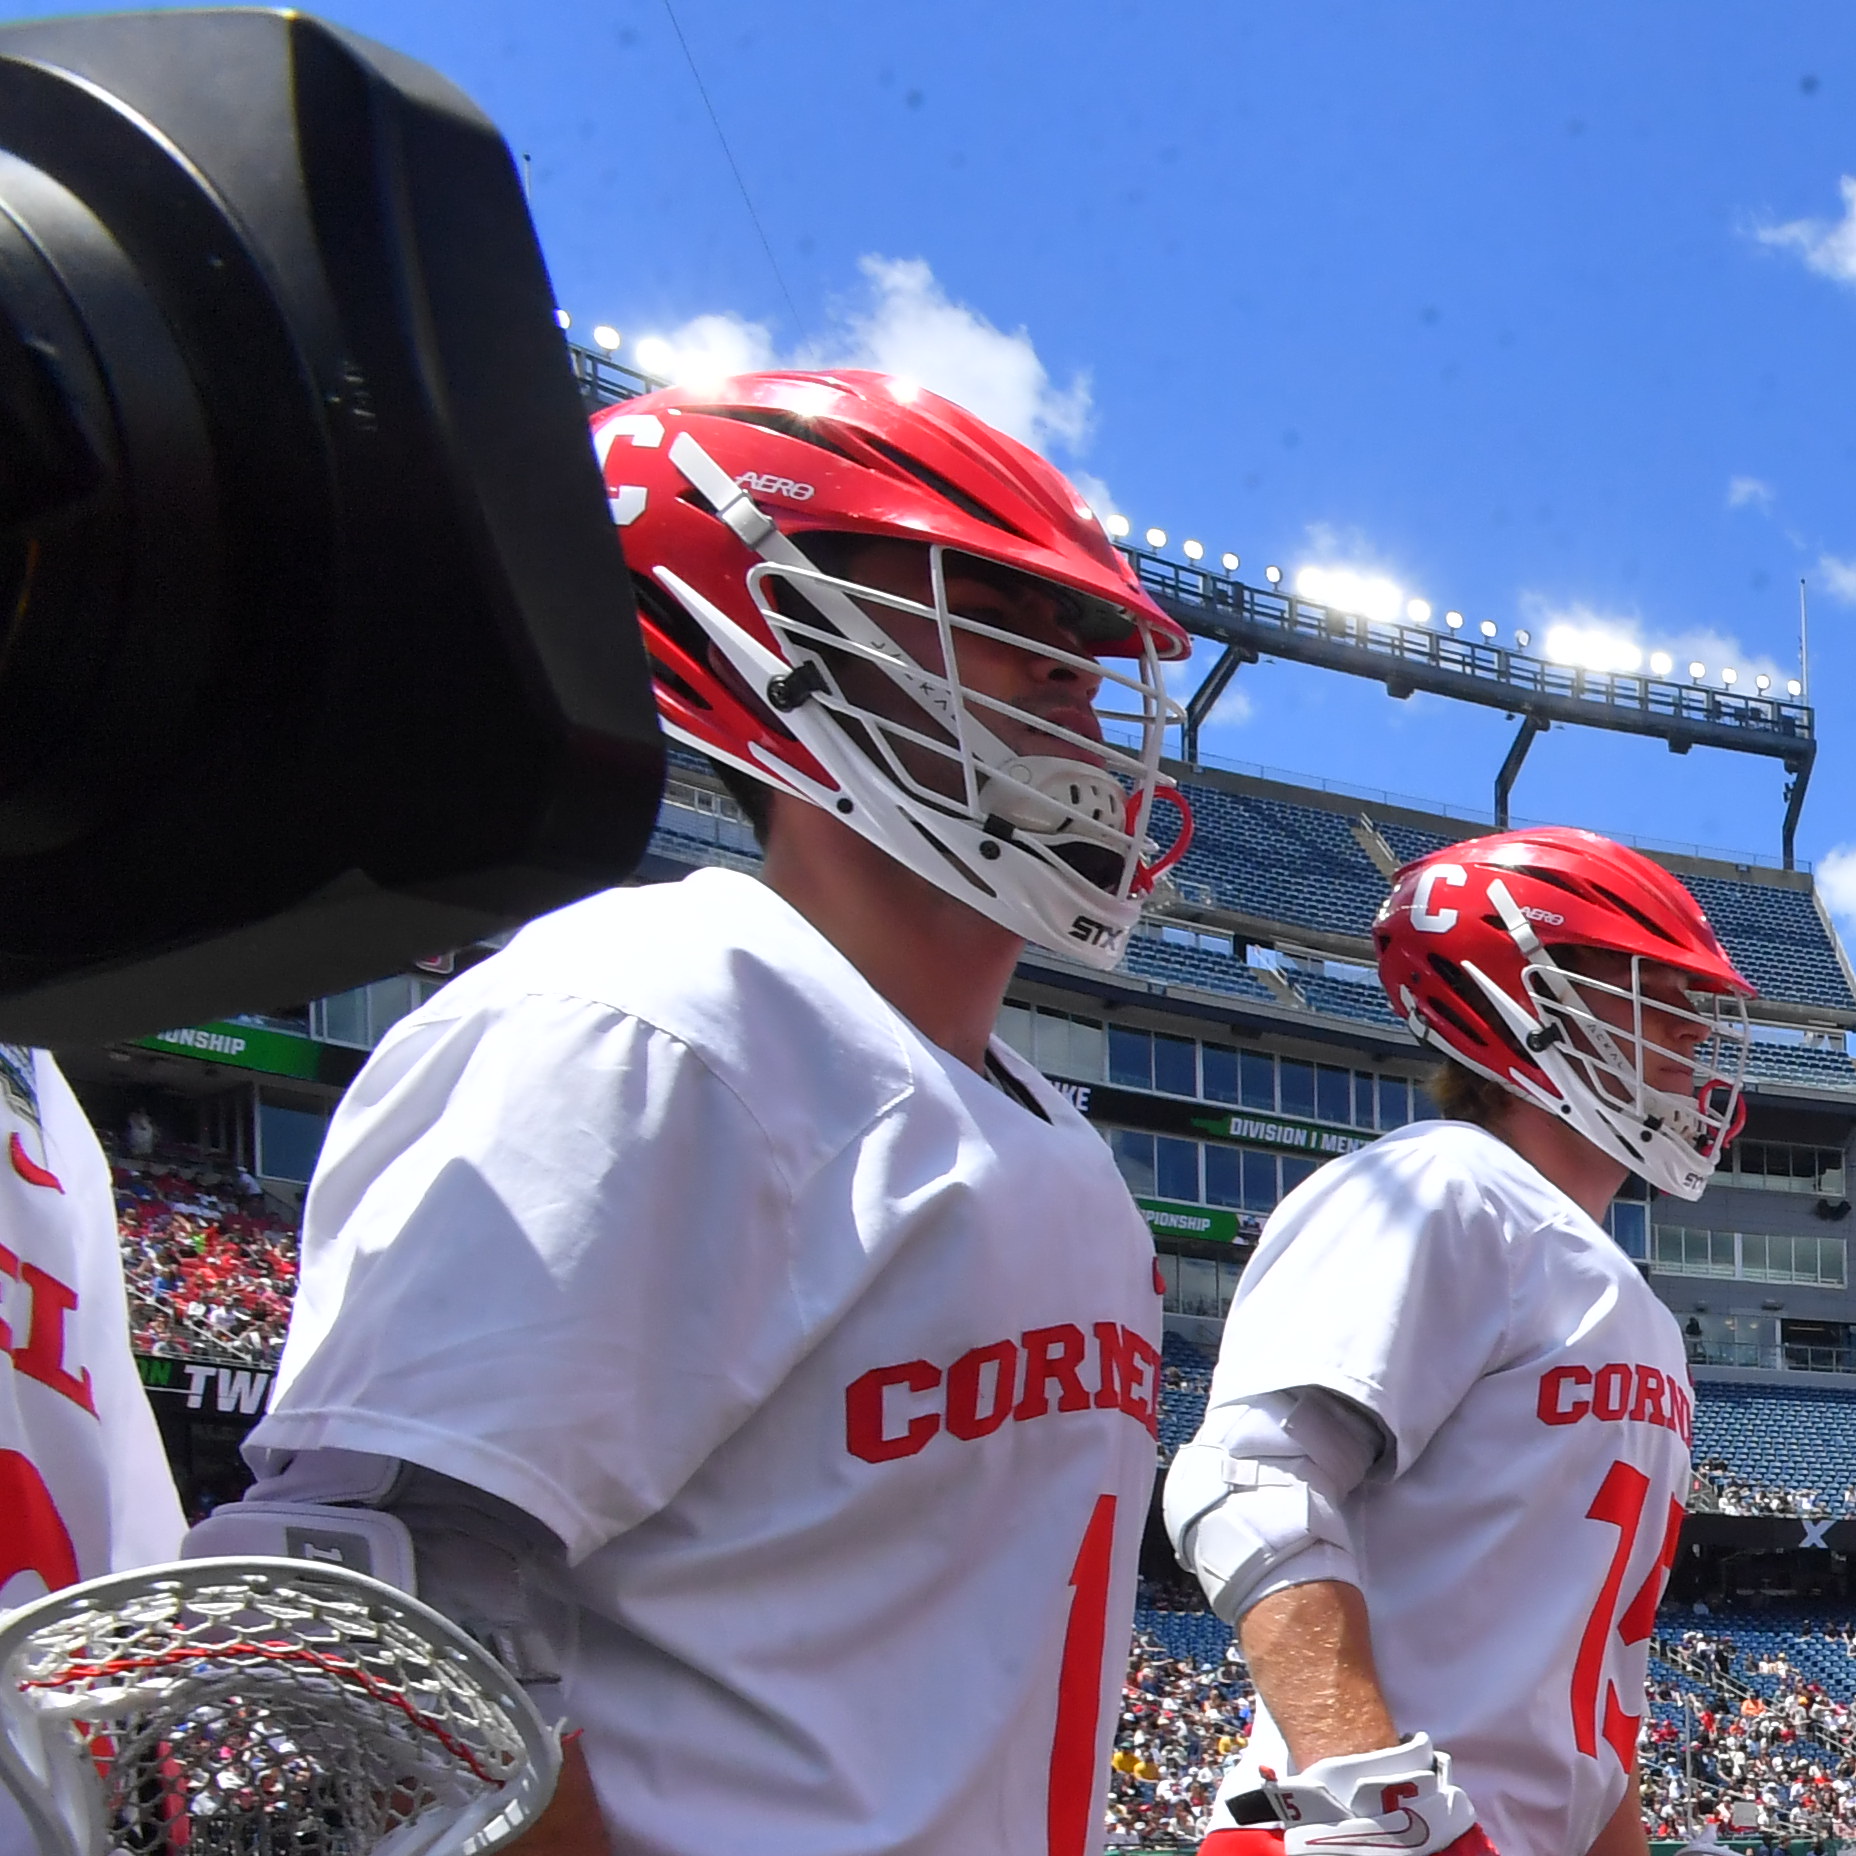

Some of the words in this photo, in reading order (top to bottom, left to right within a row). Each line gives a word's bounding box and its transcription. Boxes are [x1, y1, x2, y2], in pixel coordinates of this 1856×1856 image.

[735, 470, 815, 502] AERO
[1410, 863, 1469, 935] C
[1068, 914, 1123, 951] STX
[1521, 906, 1564, 927] AERO
[1230, 1117, 1308, 1147] DIVISION
[1310, 1133, 1317, 1149] I
[184, 1364, 278, 1415] TW
